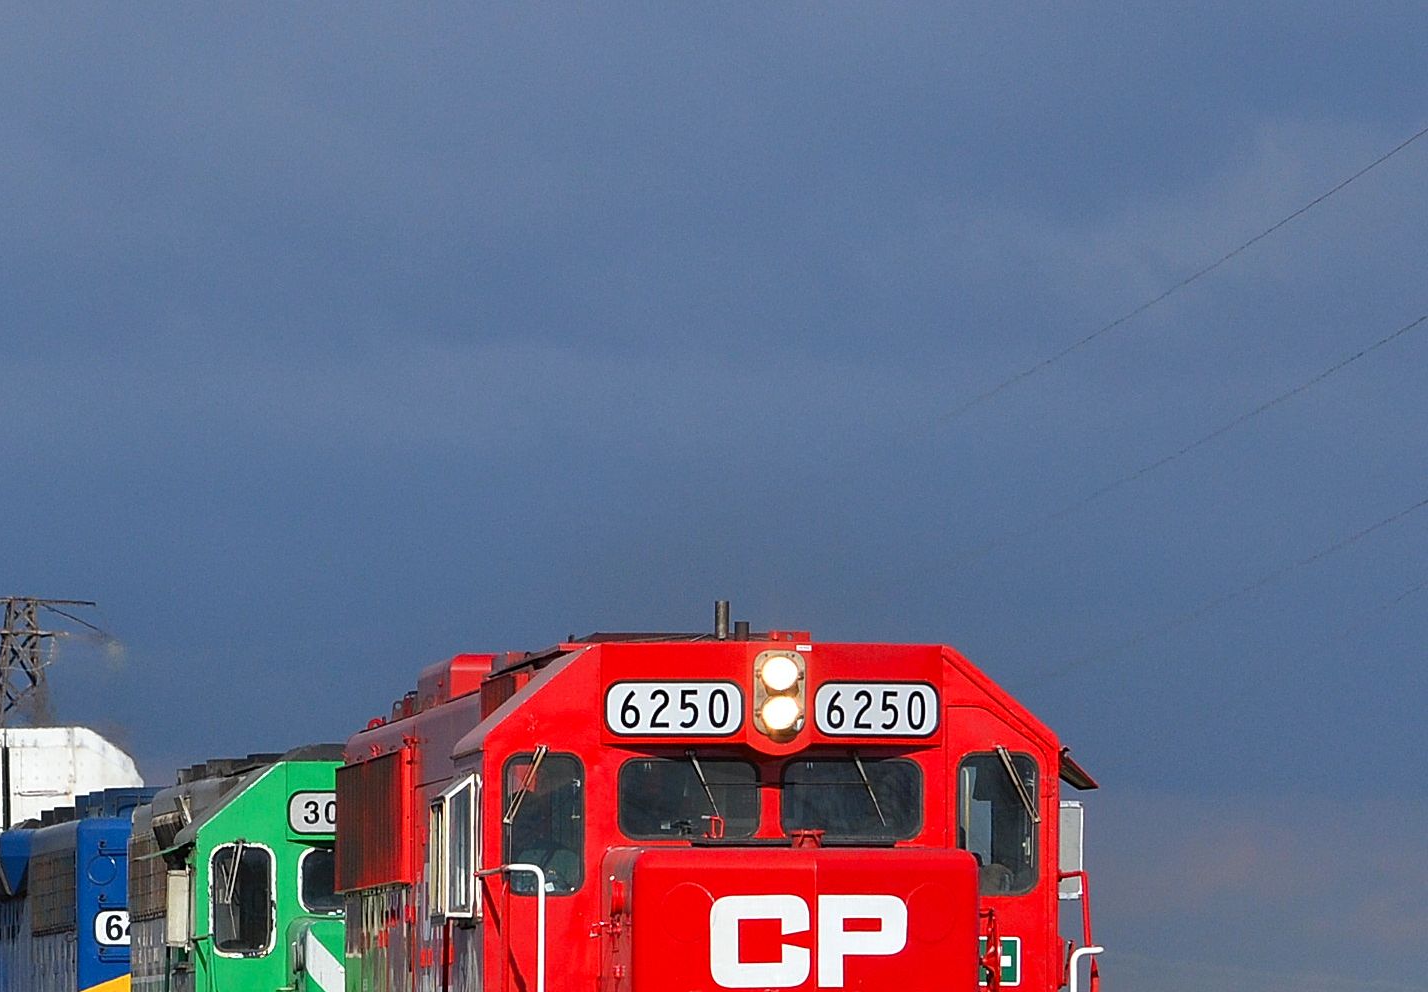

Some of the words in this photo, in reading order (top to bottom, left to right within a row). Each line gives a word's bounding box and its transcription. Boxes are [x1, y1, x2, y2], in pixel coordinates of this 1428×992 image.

[620, 688, 729, 729] 6250
[826, 690, 926, 730] 6250
[709, 894, 908, 989] CP
